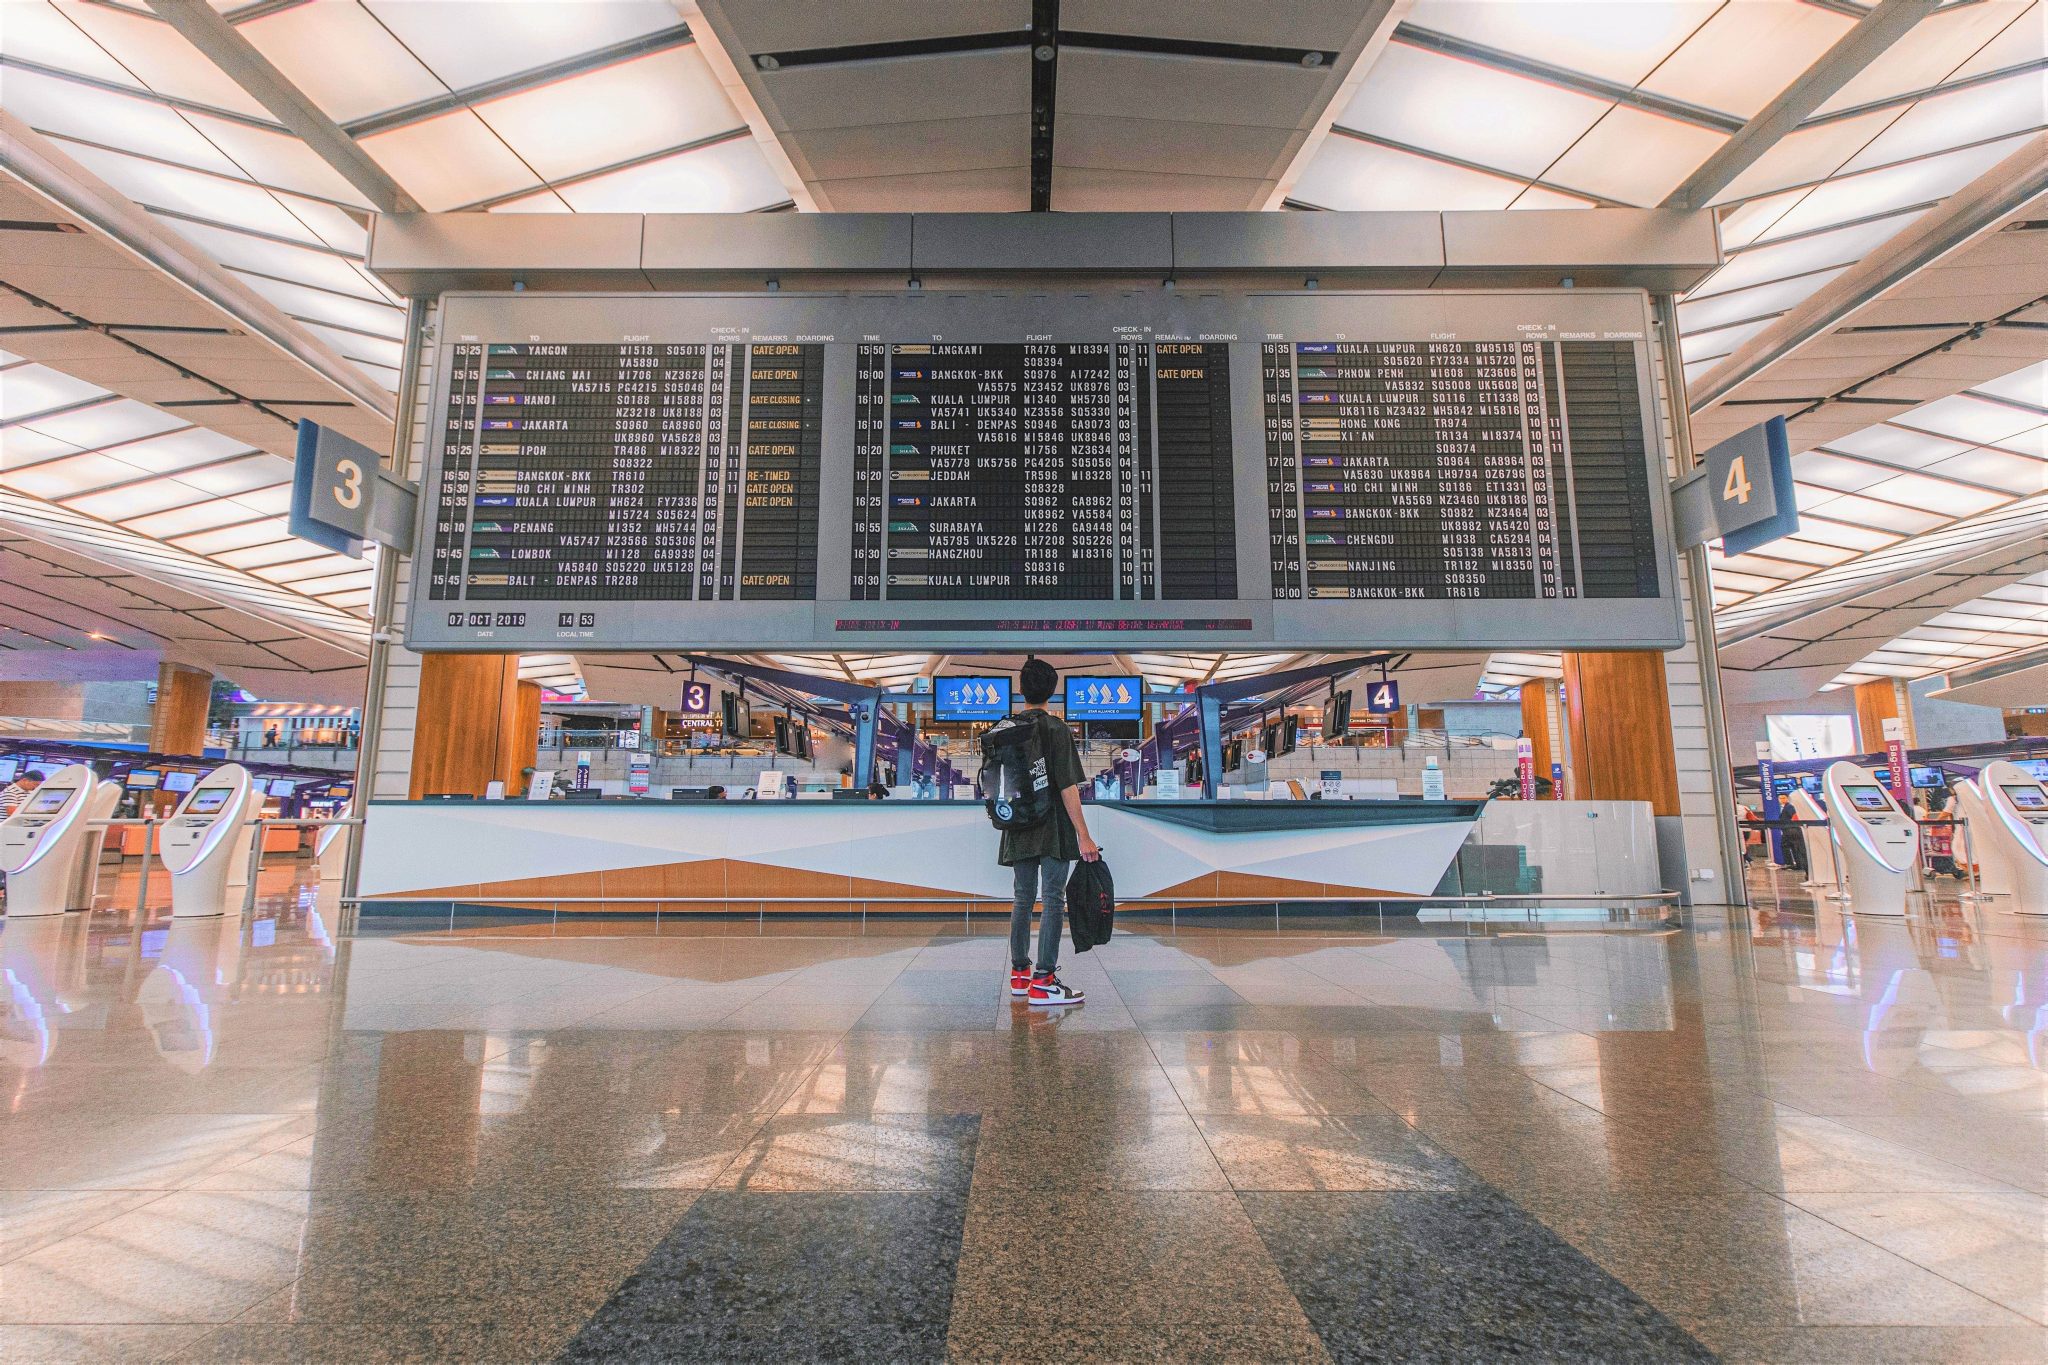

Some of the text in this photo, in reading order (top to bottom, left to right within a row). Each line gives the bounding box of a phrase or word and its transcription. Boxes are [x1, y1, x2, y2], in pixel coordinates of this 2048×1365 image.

[529, 345, 798, 355] YANGON 04 GATE OPEN
[932, 345, 1202, 355] LANGKAWI GATE OPEN
[1336, 343, 1461, 353] KUALA LUMPUR MH620
[620, 358, 659, 367] VA5890
[526, 370, 797, 380] CHIANG MAI GATE OPEN
[931, 369, 1203, 379] BANGKOK-BKK 03 GATE OPEN
[1338, 368, 1516, 378] PHNOM PENH NZ3606
[572, 383, 610, 392] VA5715
[978, 382, 1109, 392] VA5575 UK8976
[1478, 380, 1517, 390] UK5608
[524, 395, 800, 405] HANOI 03 GATE CLOSING
[931, 395, 1129, 404] KUALA LUMPUR 04
[1339, 393, 1419, 403] KUALA LUMPUR
[616, 408, 656, 417] NZ3218
[931, 407, 1063, 417] VA5741 NZ3556
[1340, 405, 1473, 416] UK8116 MH5842
[522, 420, 799, 430] JAKARTA GA8960 GATE CLOSING
[931, 420, 1017, 430] BALI DENPAS
[1341, 419, 1400, 428] HONG KONG
[662, 433, 701, 442] VA5628
[977, 433, 1017, 442] VA5616
[1435, 431, 1468, 440] TR134
[521, 445, 795, 455] IPOH GATE OPEN
[931, 445, 970, 455] PHUKET
[1024, 445, 1057, 455] MI756
[1071, 445, 1111, 455] NZ3634
[977, 458, 1017, 468] UK5756
[1343, 457, 1389, 467] JAKARTA
[518, 471, 591, 481] BANGKOK-BKK
[612, 471, 645, 481] TR610
[708, 472, 718, 480] 10
[747, 471, 790, 481] RE-TIMED
[931, 471, 1151, 481] JEDDAH TR596 10 11
[1343, 469, 1478, 479] VA5630 LH9794
[334, 459, 362, 509] 3
[1723, 455, 1752, 504] 4
[516, 484, 793, 494] HO CHI MINH GATE OPEN
[1344, 482, 1418, 492] HO CHI MINH
[515, 497, 793, 507] KUALA LUMPUR MH624 05 GATE OPEN
[930, 497, 976, 506] JAKARTA
[1392, 495, 1527, 505] VA5569 UK8186
[1024, 509, 1064, 519] UK8962
[1345, 508, 1419, 518] BANGKOK-BKK
[513, 523, 695, 533] PENANG MH5744
[930, 522, 1112, 532] SURABAYA MI226 GA9448
[1441, 521, 1482, 531] UK8982
[607, 536, 647, 546] NZ3566
[977, 536, 1017, 545] UK5226
[1347, 534, 1530, 545] CHENGDU CA5294
[511, 549, 640, 559] LOMBOK MI128
[929, 549, 1058, 559] HANGZHOU TR188
[1443, 547, 1484, 557] SQ5138
[558, 562, 598, 572] VA5840
[1348, 561, 1478, 571] NANJING TR182
[509, 575, 789, 585] BALI DENPAS TR288 GATE OPEN
[928, 575, 1010, 585] KUALA LUMPUR
[1350, 588, 1425, 598] BANGKOK-BKK
[688, 685, 704, 710] 3
[1374, 685, 1393, 709] 4
[1889, 745, 1901, 787] Bag-Drop
